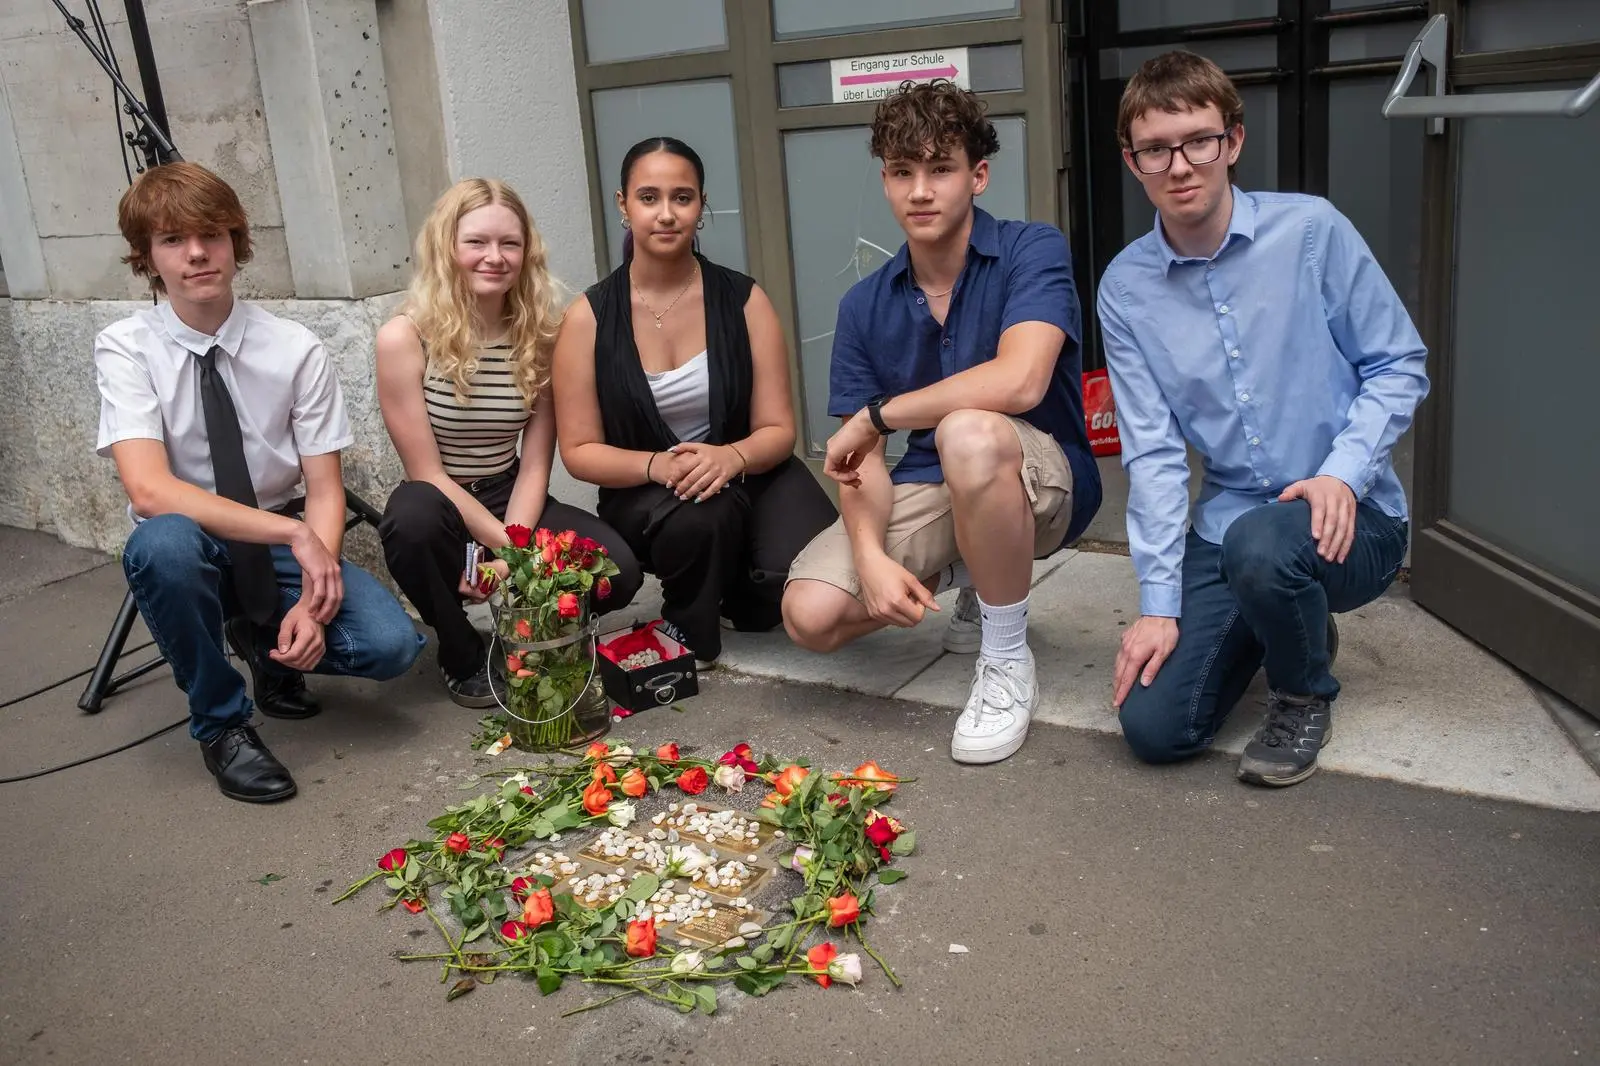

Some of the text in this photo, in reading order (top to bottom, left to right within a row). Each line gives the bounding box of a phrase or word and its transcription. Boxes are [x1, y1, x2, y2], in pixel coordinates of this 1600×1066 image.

[851, 53, 944, 72] Eingang zur Schule
[843, 90, 863, 101] über
